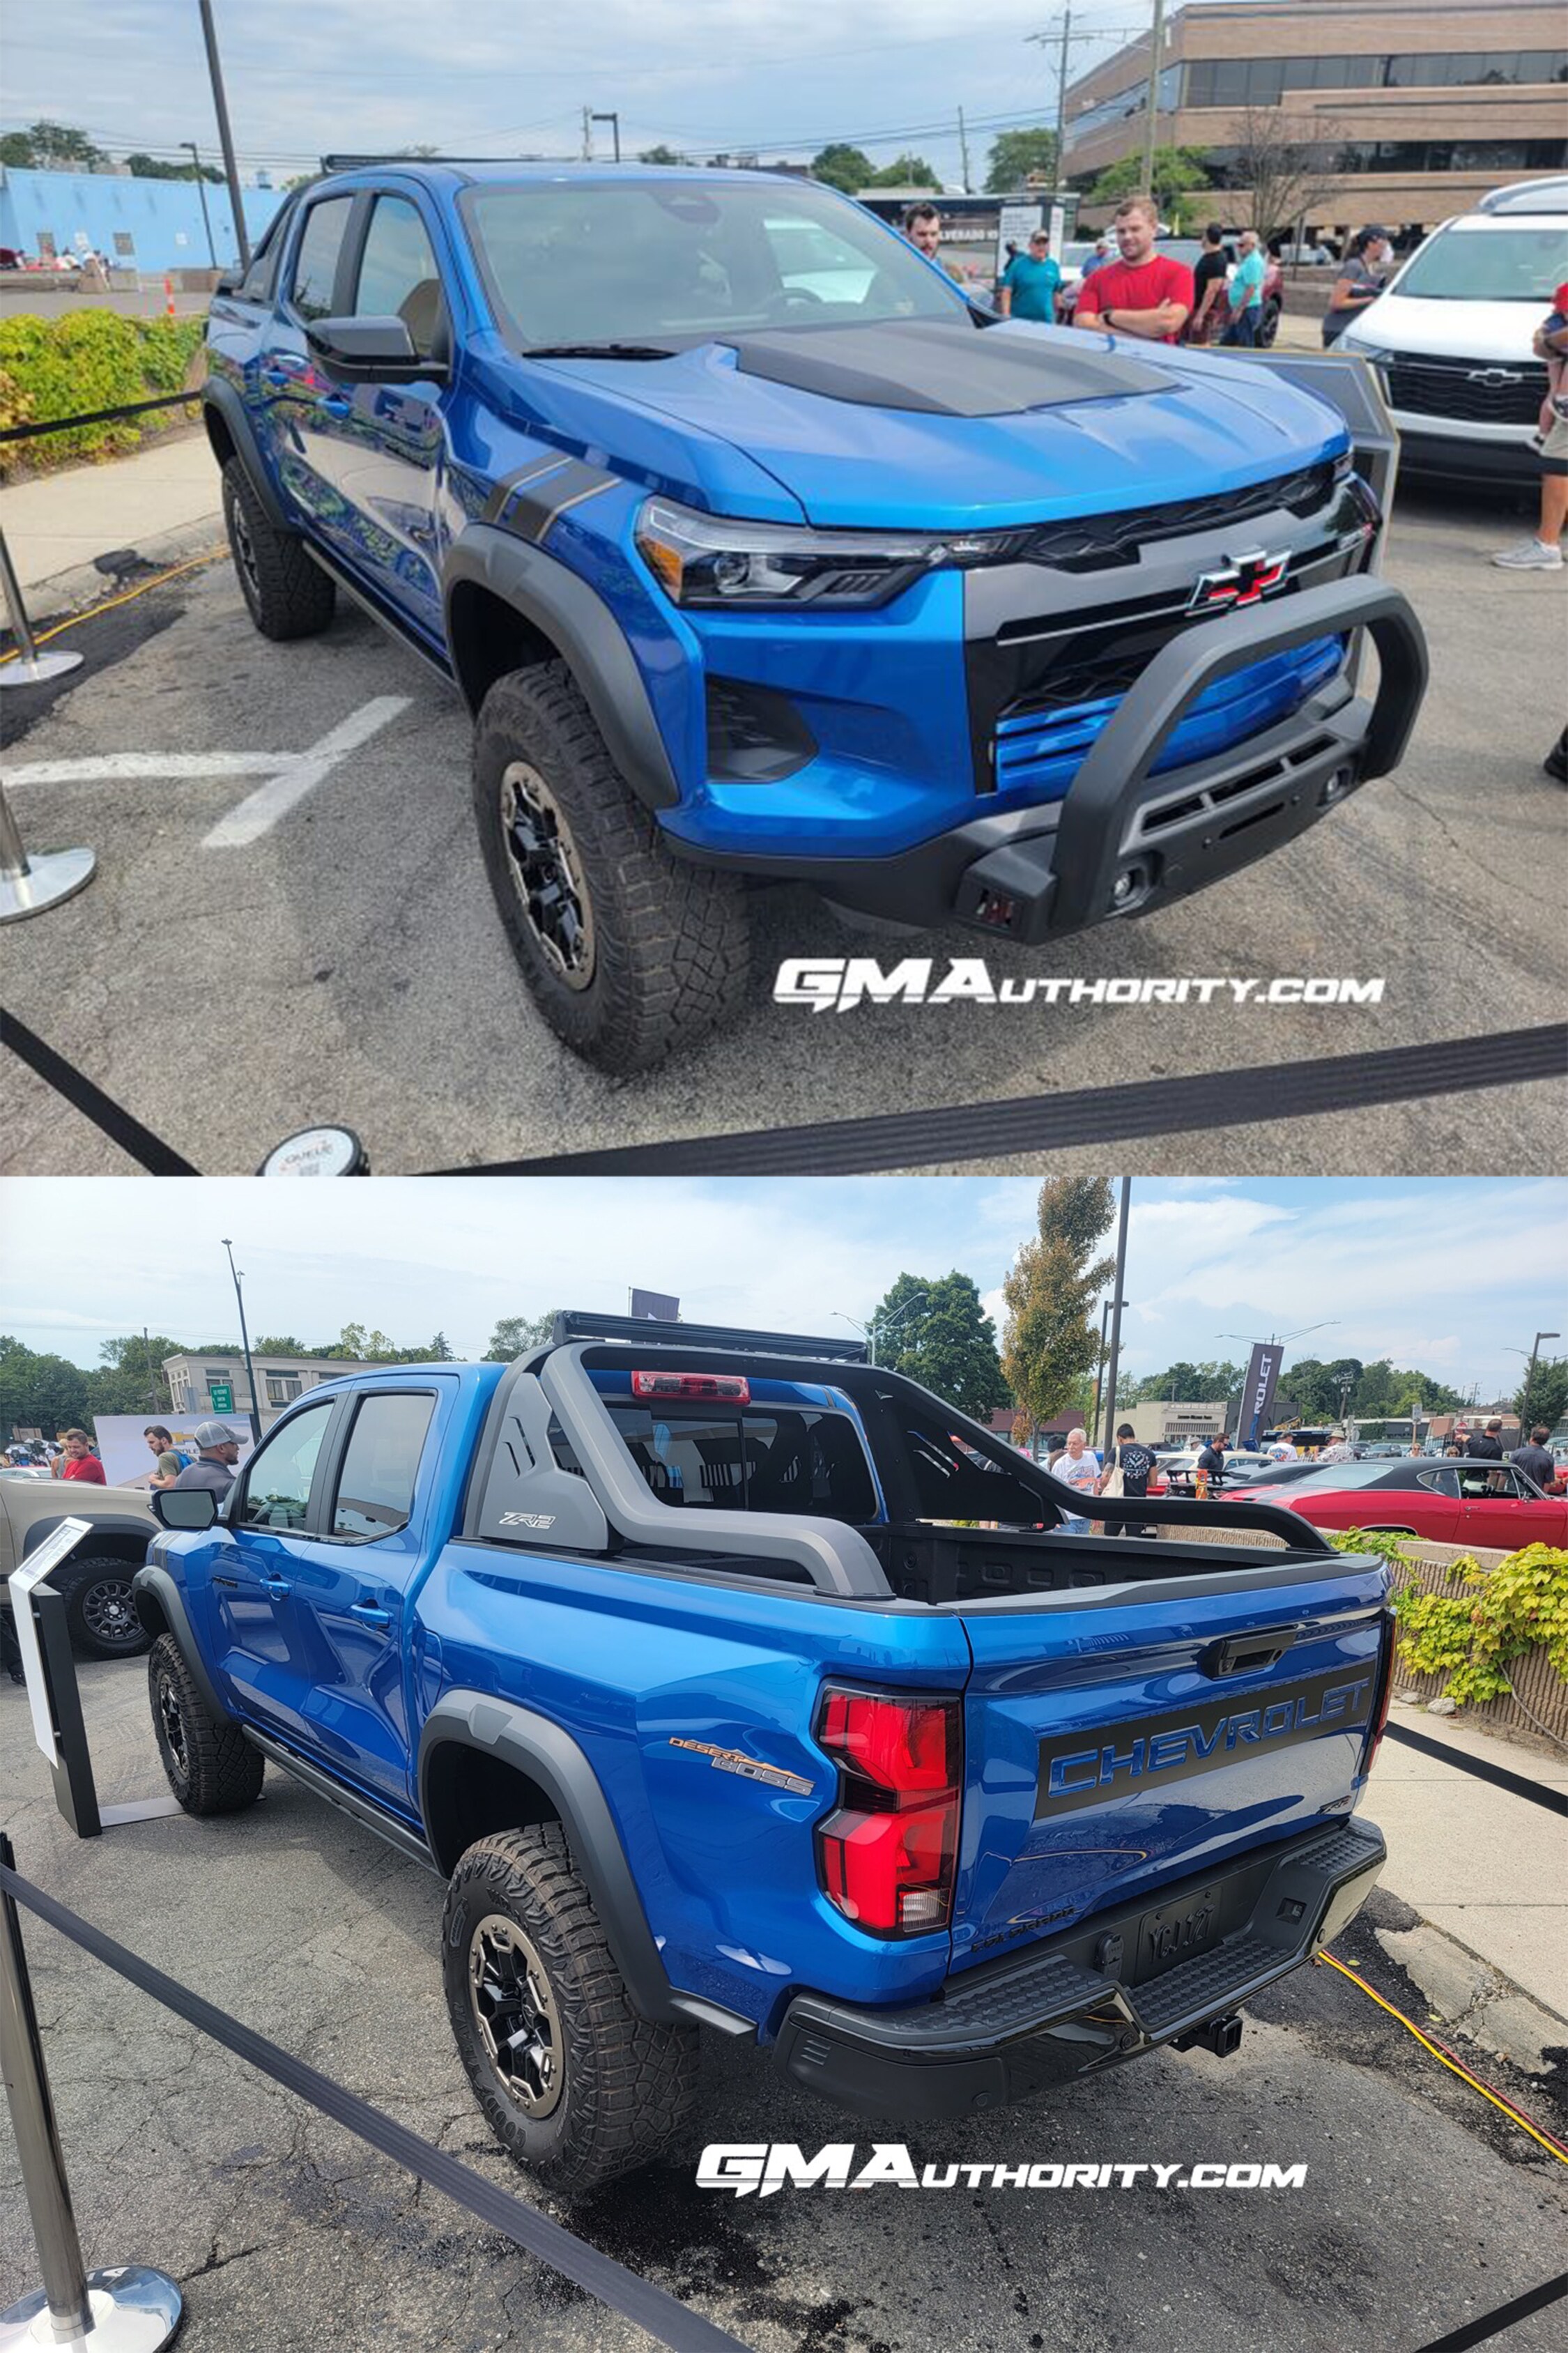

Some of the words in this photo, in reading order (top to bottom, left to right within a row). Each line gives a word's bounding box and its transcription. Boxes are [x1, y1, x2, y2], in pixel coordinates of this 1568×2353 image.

[499, 1511, 556, 1530] ZR2
[669, 1737, 745, 1763] DESERT
[1047, 1677, 1370, 1798] CHEVROLET
[711, 1756, 815, 1797] BOSS
